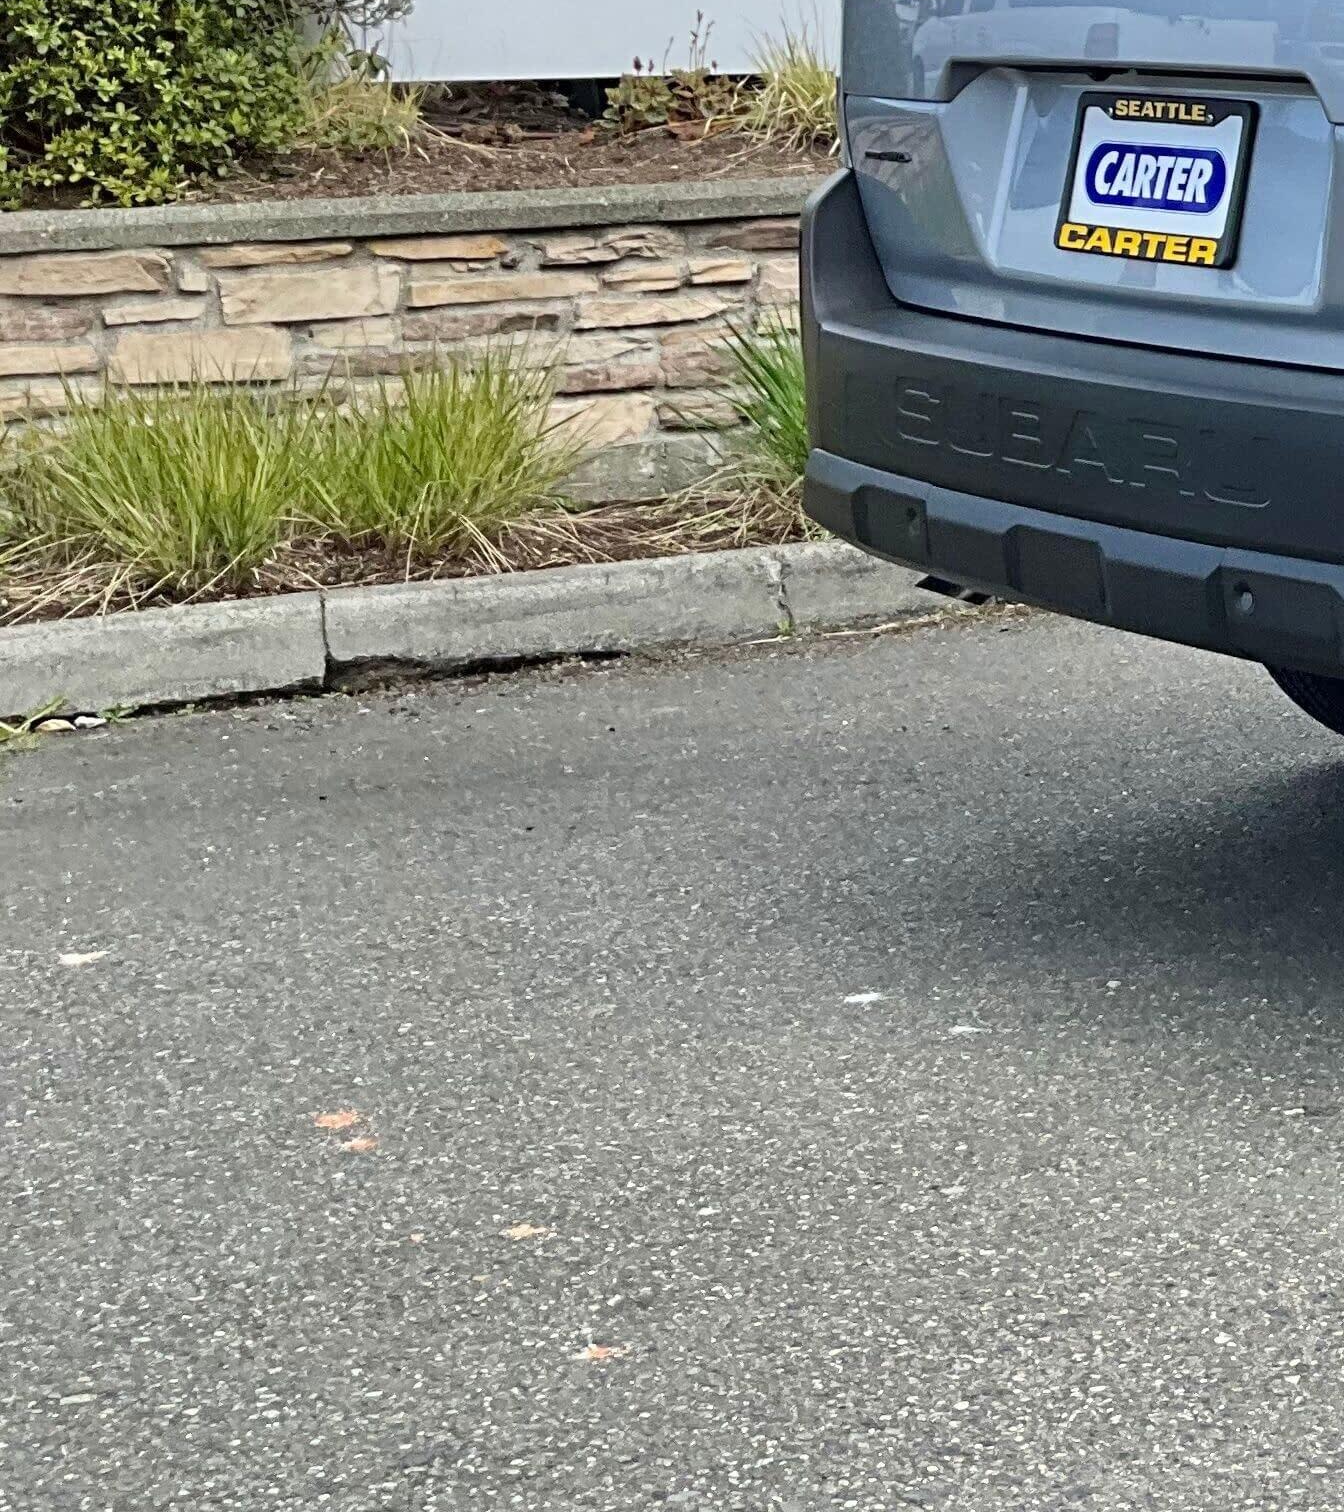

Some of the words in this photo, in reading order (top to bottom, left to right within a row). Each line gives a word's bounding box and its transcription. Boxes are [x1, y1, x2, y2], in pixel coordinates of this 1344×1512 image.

[1115, 99, 1207, 122] SEATTLE
[1094, 150, 1214, 204] CARTER
[1058, 223, 1218, 266] CARTER
[895, 375, 1273, 510] SUBARU
